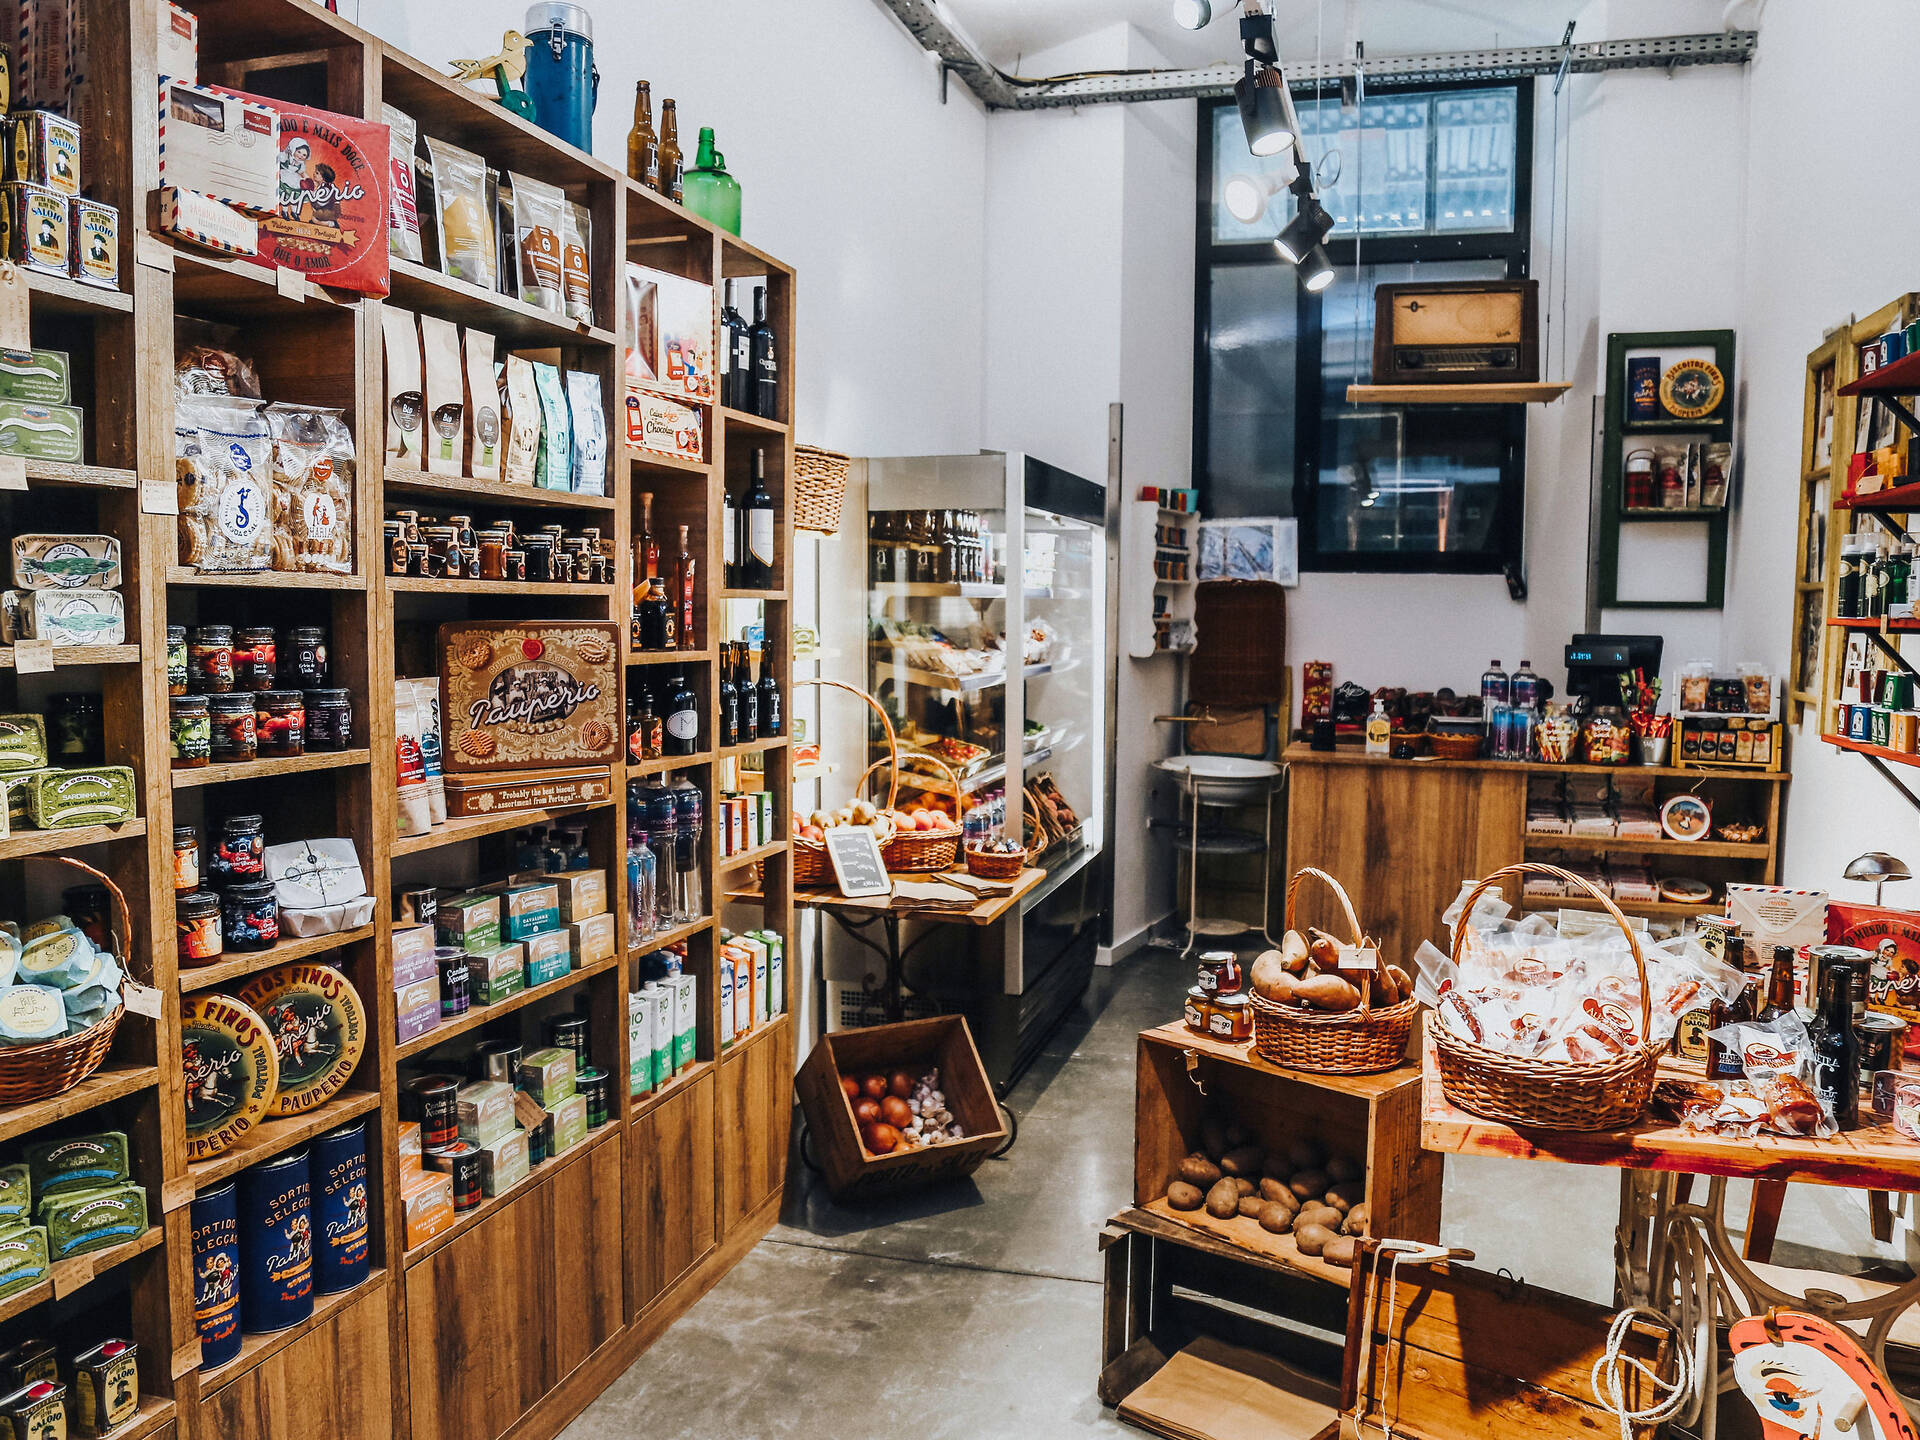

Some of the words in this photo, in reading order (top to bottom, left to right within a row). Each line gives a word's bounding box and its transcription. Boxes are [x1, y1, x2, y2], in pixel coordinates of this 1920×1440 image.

[312, 124, 342, 148] MAIS
[280, 180, 365, 214] upério
[32, 207, 63, 223] SALOIO
[84, 223, 113, 238] SALOIO
[314, 228, 337, 240] Portugal
[273, 246, 291, 263] QUE
[305, 256, 331, 268] AMOR
[1666, 361, 1704, 381] BISCOITOS
[470, 681, 600, 729] Paupério
[70, 776, 109, 787] GONDOLA
[531, 788, 541, 796] the
[556, 784, 576, 793] biscuit
[62, 792, 98, 800] SARDINHA
[533, 796, 547, 805] from
[1700, 933, 1723, 946] ALOIO
[1854, 924, 1888, 942] MUNDO
[291, 967, 344, 1000] FINOS
[203, 1001, 262, 1047] FINOS
[340, 994, 358, 1042] PORTUGAL
[629, 1012, 643, 1026] IO
[1684, 1019, 1709, 1030] SALOIO
[278, 1003, 332, 1058] upério
[252, 1046, 269, 1100] PORTUGAL
[281, 1059, 353, 1112] PAUPÉRIO
[187, 1116, 252, 1158] UPÉRIO
[329, 1153, 367, 1178] SORTI
[84, 1201, 124, 1212] GONDOLA
[269, 1182, 310, 1209] SORTI
[192, 1218, 236, 1240] ORTIDO
[108, 1367, 135, 1387] SALOIO
[31, 1412, 62, 1434] SALOIO
